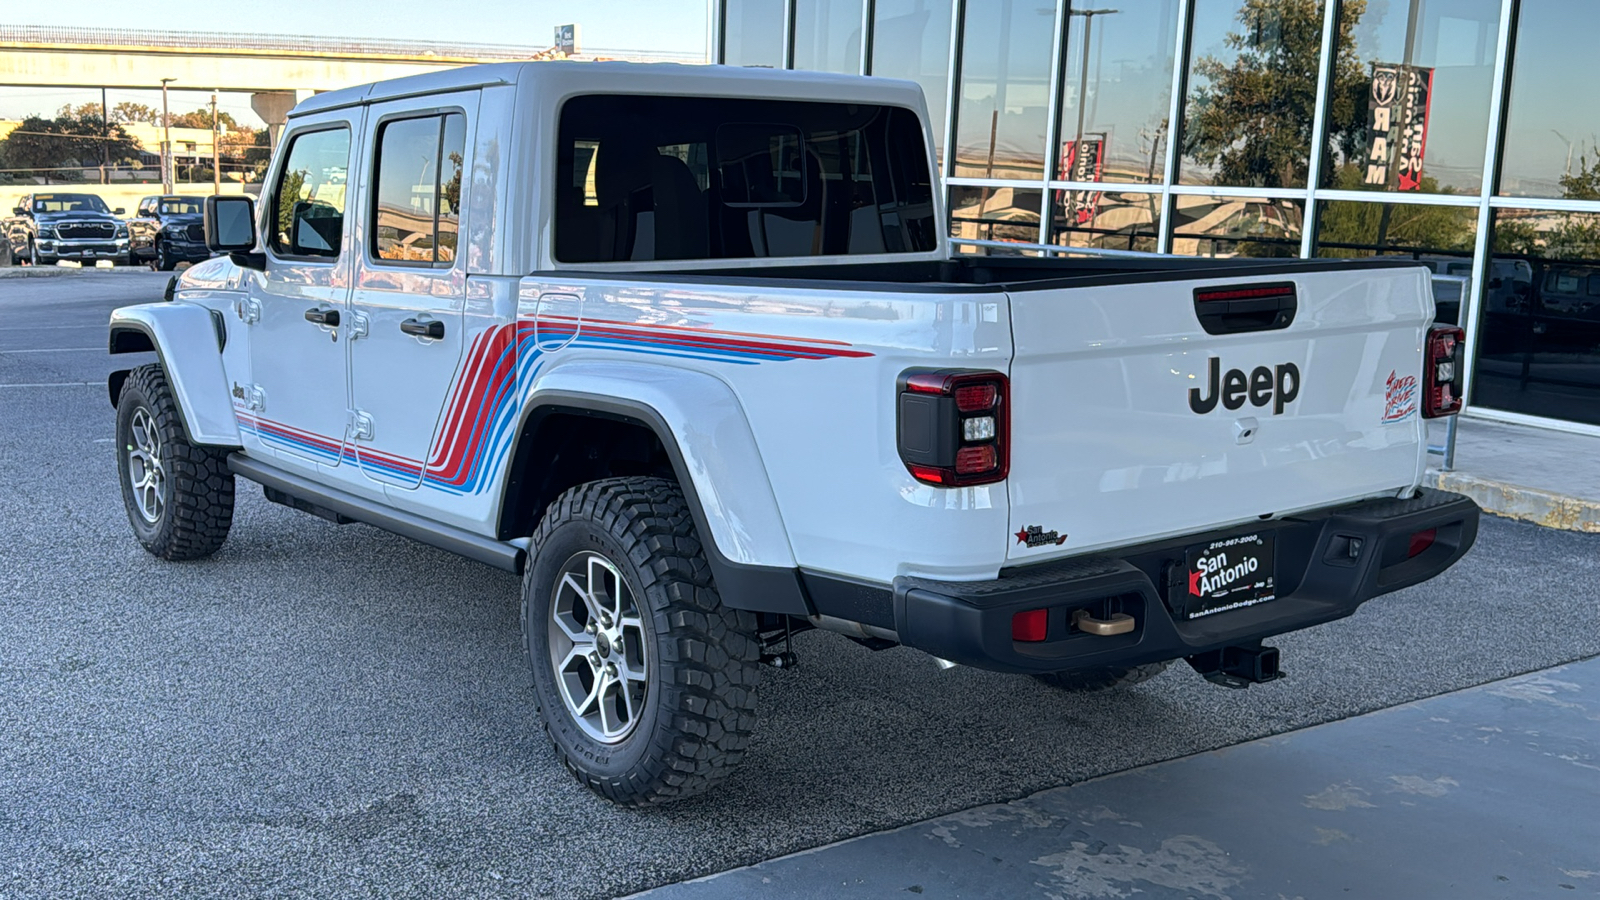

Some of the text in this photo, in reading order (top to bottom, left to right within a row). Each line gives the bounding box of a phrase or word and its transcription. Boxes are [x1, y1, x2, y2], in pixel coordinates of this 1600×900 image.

[1188, 356, 1300, 415] Jeep
[1027, 526, 1042, 536] San
[1027, 530, 1059, 543] Antonio
[1196, 552, 1228, 577] San
[1199, 556, 1259, 597] Antonio
[1189, 594, 1276, 619] SanAntonioDodge.com
